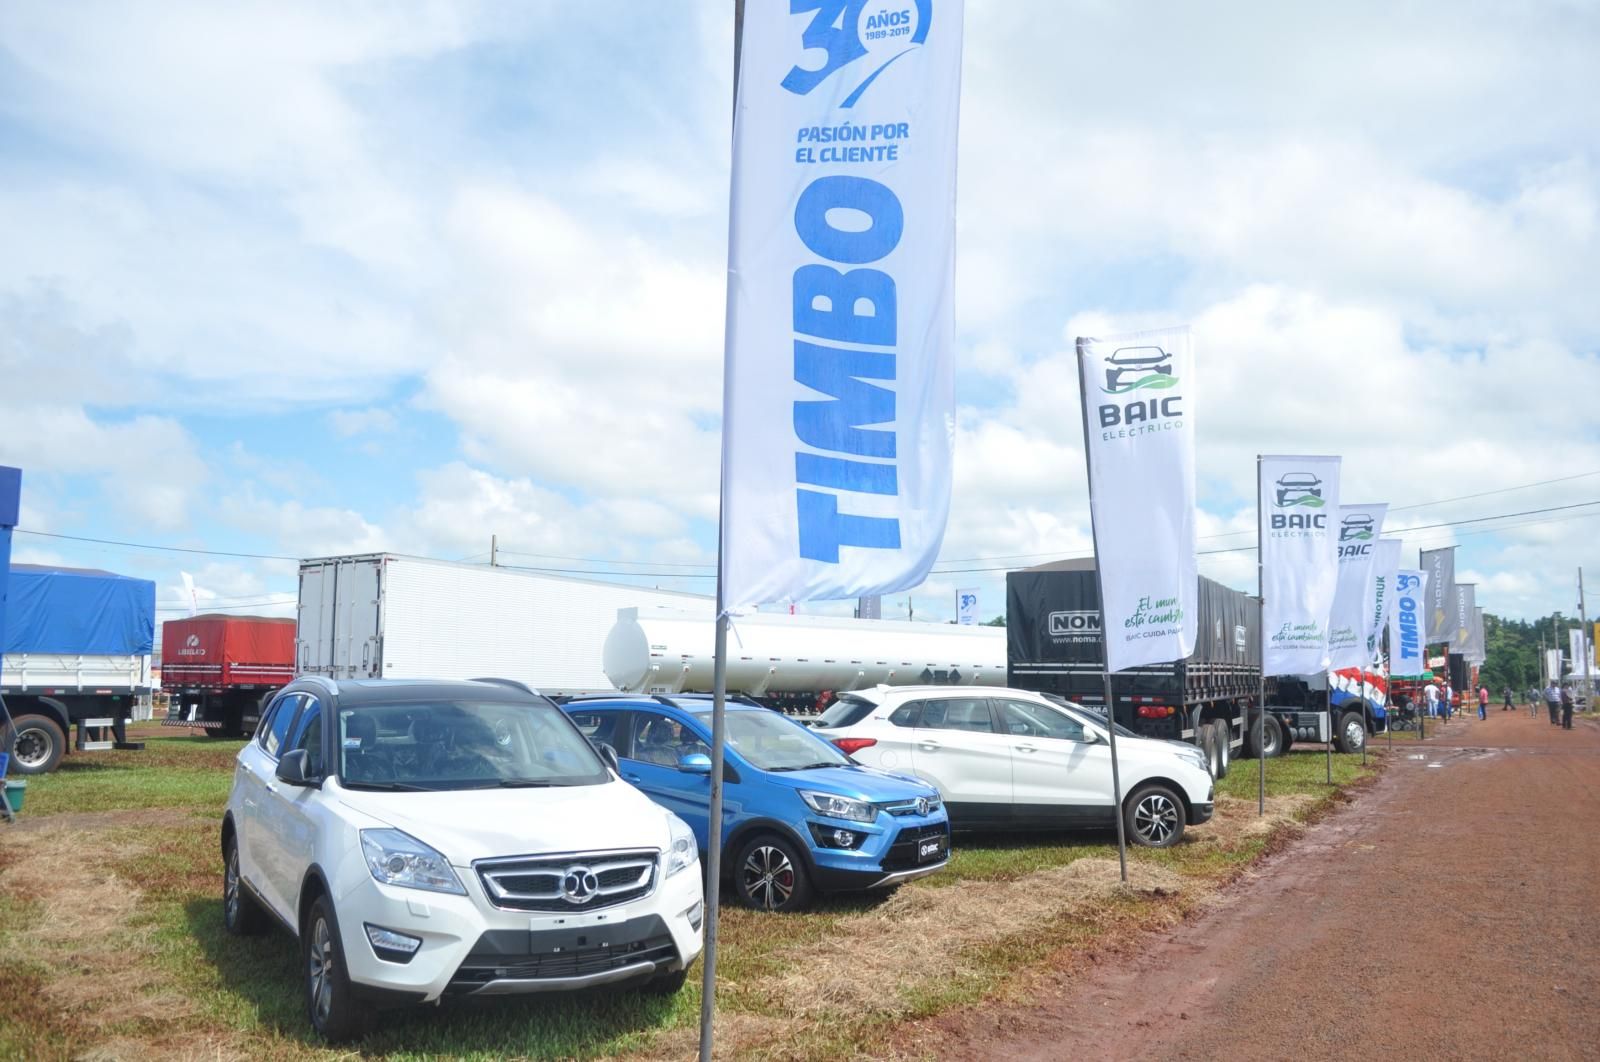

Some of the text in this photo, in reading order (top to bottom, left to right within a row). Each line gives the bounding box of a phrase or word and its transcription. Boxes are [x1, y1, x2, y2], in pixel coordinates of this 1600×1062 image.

[866, 9, 910, 29] AÑOS
[865, 26, 910, 40] 1989-2019
[797, 121, 909, 143] PASIÓN POR
[795, 145, 899, 163] EL CLIENTE
[792, 175, 904, 564] TIMBO
[1099, 396, 1183, 428] BAIC
[1271, 514, 1327, 529] BAIC
[1139, 596, 1177, 611] El mun
[1053, 615, 1101, 630] NOM
[1124, 608, 1148, 628] está
[1143, 630, 1166, 638] CUIDA
[1399, 597, 1419, 659] TIMBO
